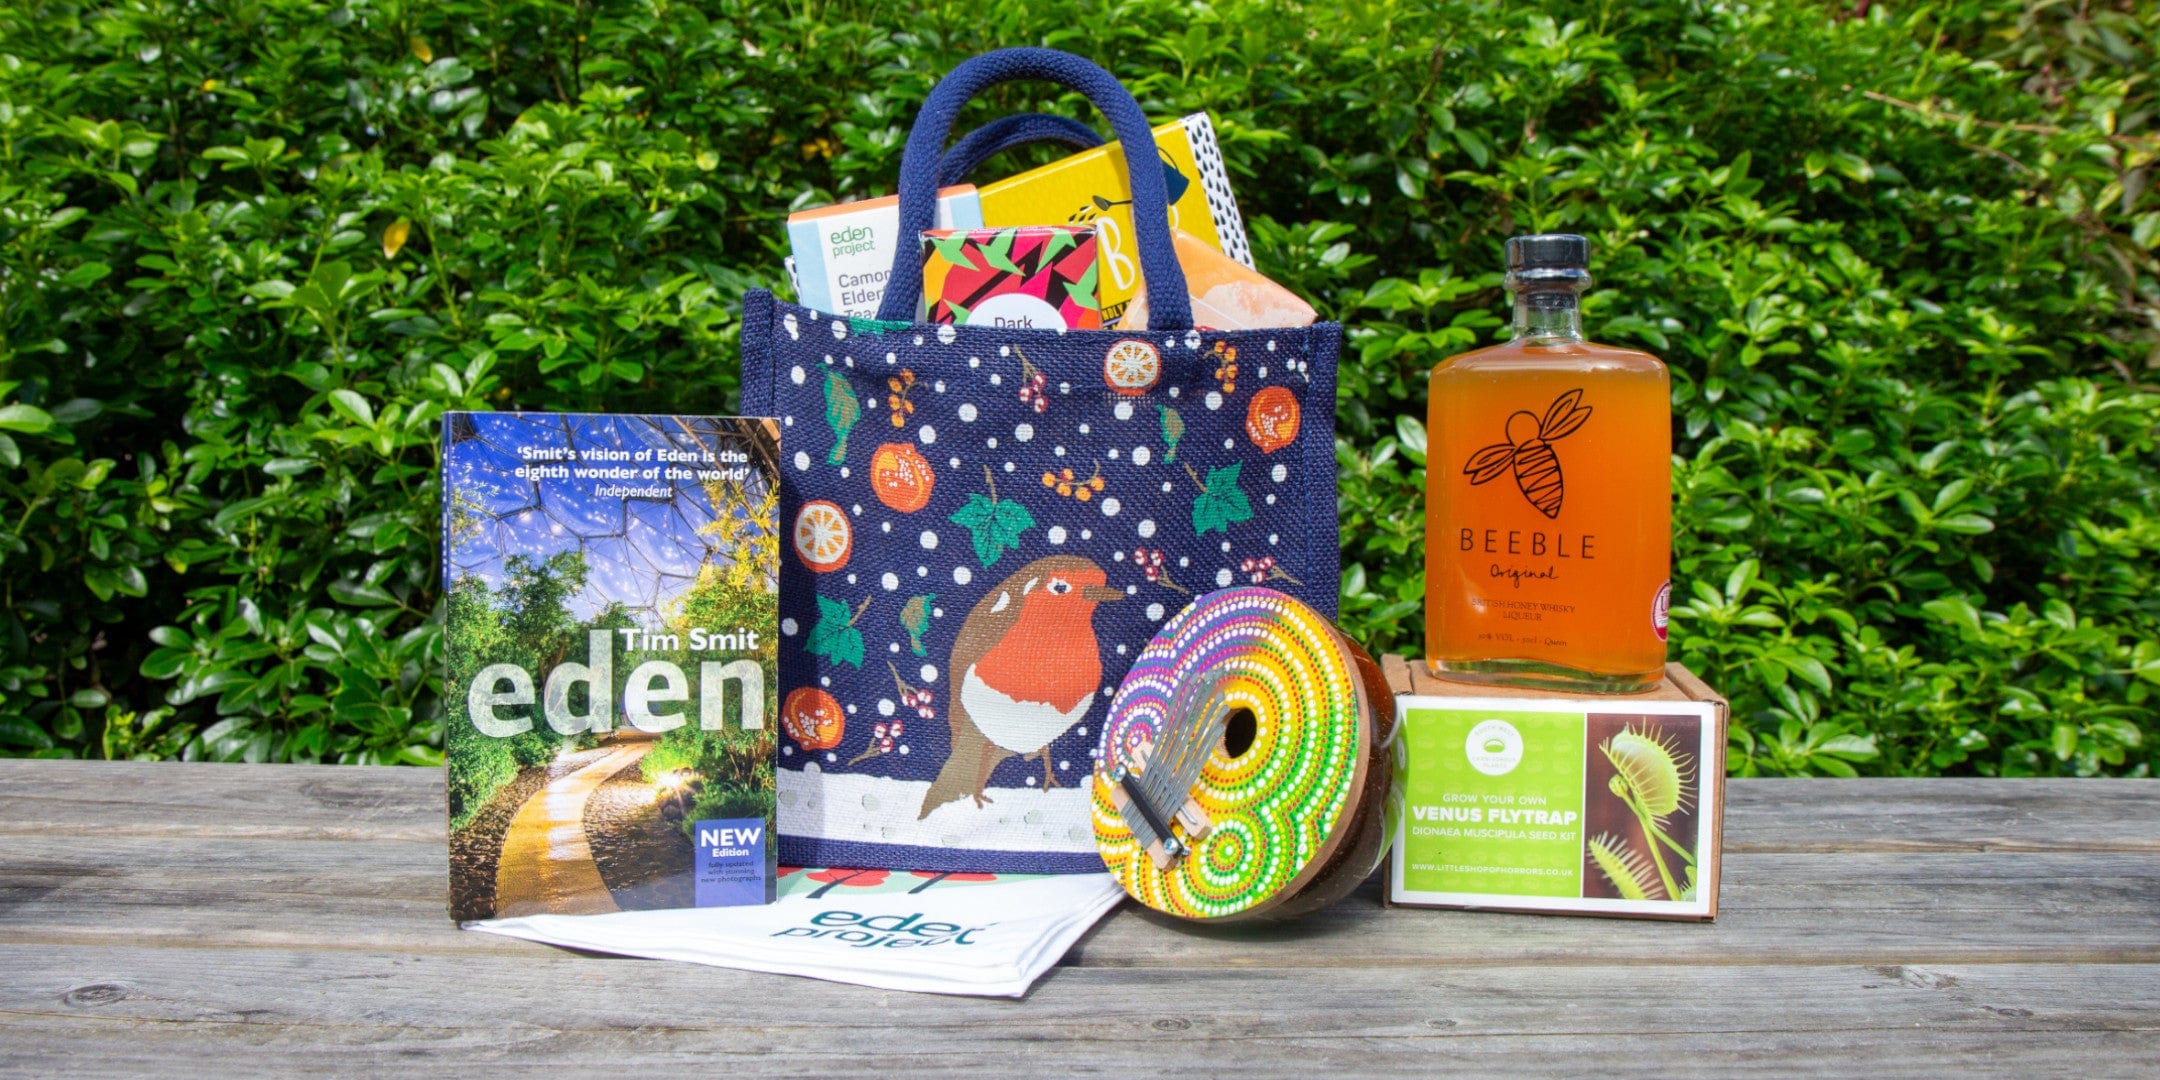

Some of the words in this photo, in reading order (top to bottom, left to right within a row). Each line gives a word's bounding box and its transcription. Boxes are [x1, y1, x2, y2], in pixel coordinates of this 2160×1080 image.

[830, 225, 874, 244] eden
[832, 240, 875, 259] project
[994, 315, 1033, 329] Dark
[581, 448, 632, 462] vision
[635, 448, 653, 462] of
[657, 449, 698, 463] Eden
[703, 449, 716, 463] is
[720, 449, 748, 463] the
[514, 465, 570, 482] eighth
[574, 466, 639, 480] wonder
[643, 466, 661, 480] of
[664, 466, 693, 480] the
[595, 484, 673, 499] Independent
[1460, 528, 1595, 559] BEEBLE
[1490, 564, 1559, 588] Original
[1507, 600, 1538, 610] HONEY
[1539, 602, 1576, 613] WHISKY
[1503, 611, 1542, 621] LIQUEUR
[619, 628, 679, 651] Tim
[689, 627, 760, 651] Smit
[468, 629, 765, 738] eden
[1442, 793, 1477, 803] GROW
[1482, 795, 1515, 805] YOUR
[1518, 796, 1547, 806] OWN
[1412, 806, 1482, 823] VENUS
[1488, 808, 1578, 826] FLYTRAP
[701, 827, 762, 848] NEW
[1412, 827, 1460, 837] DIONAEA
[1463, 828, 1527, 840] MUSCIPULA
[1529, 831, 1557, 840] SEED
[1560, 832, 1577, 842] KIT
[712, 847, 750, 858] Edition
[1411, 863, 1574, 877] WWW.LITTLESHOPOFHORRORS.CO.UK
